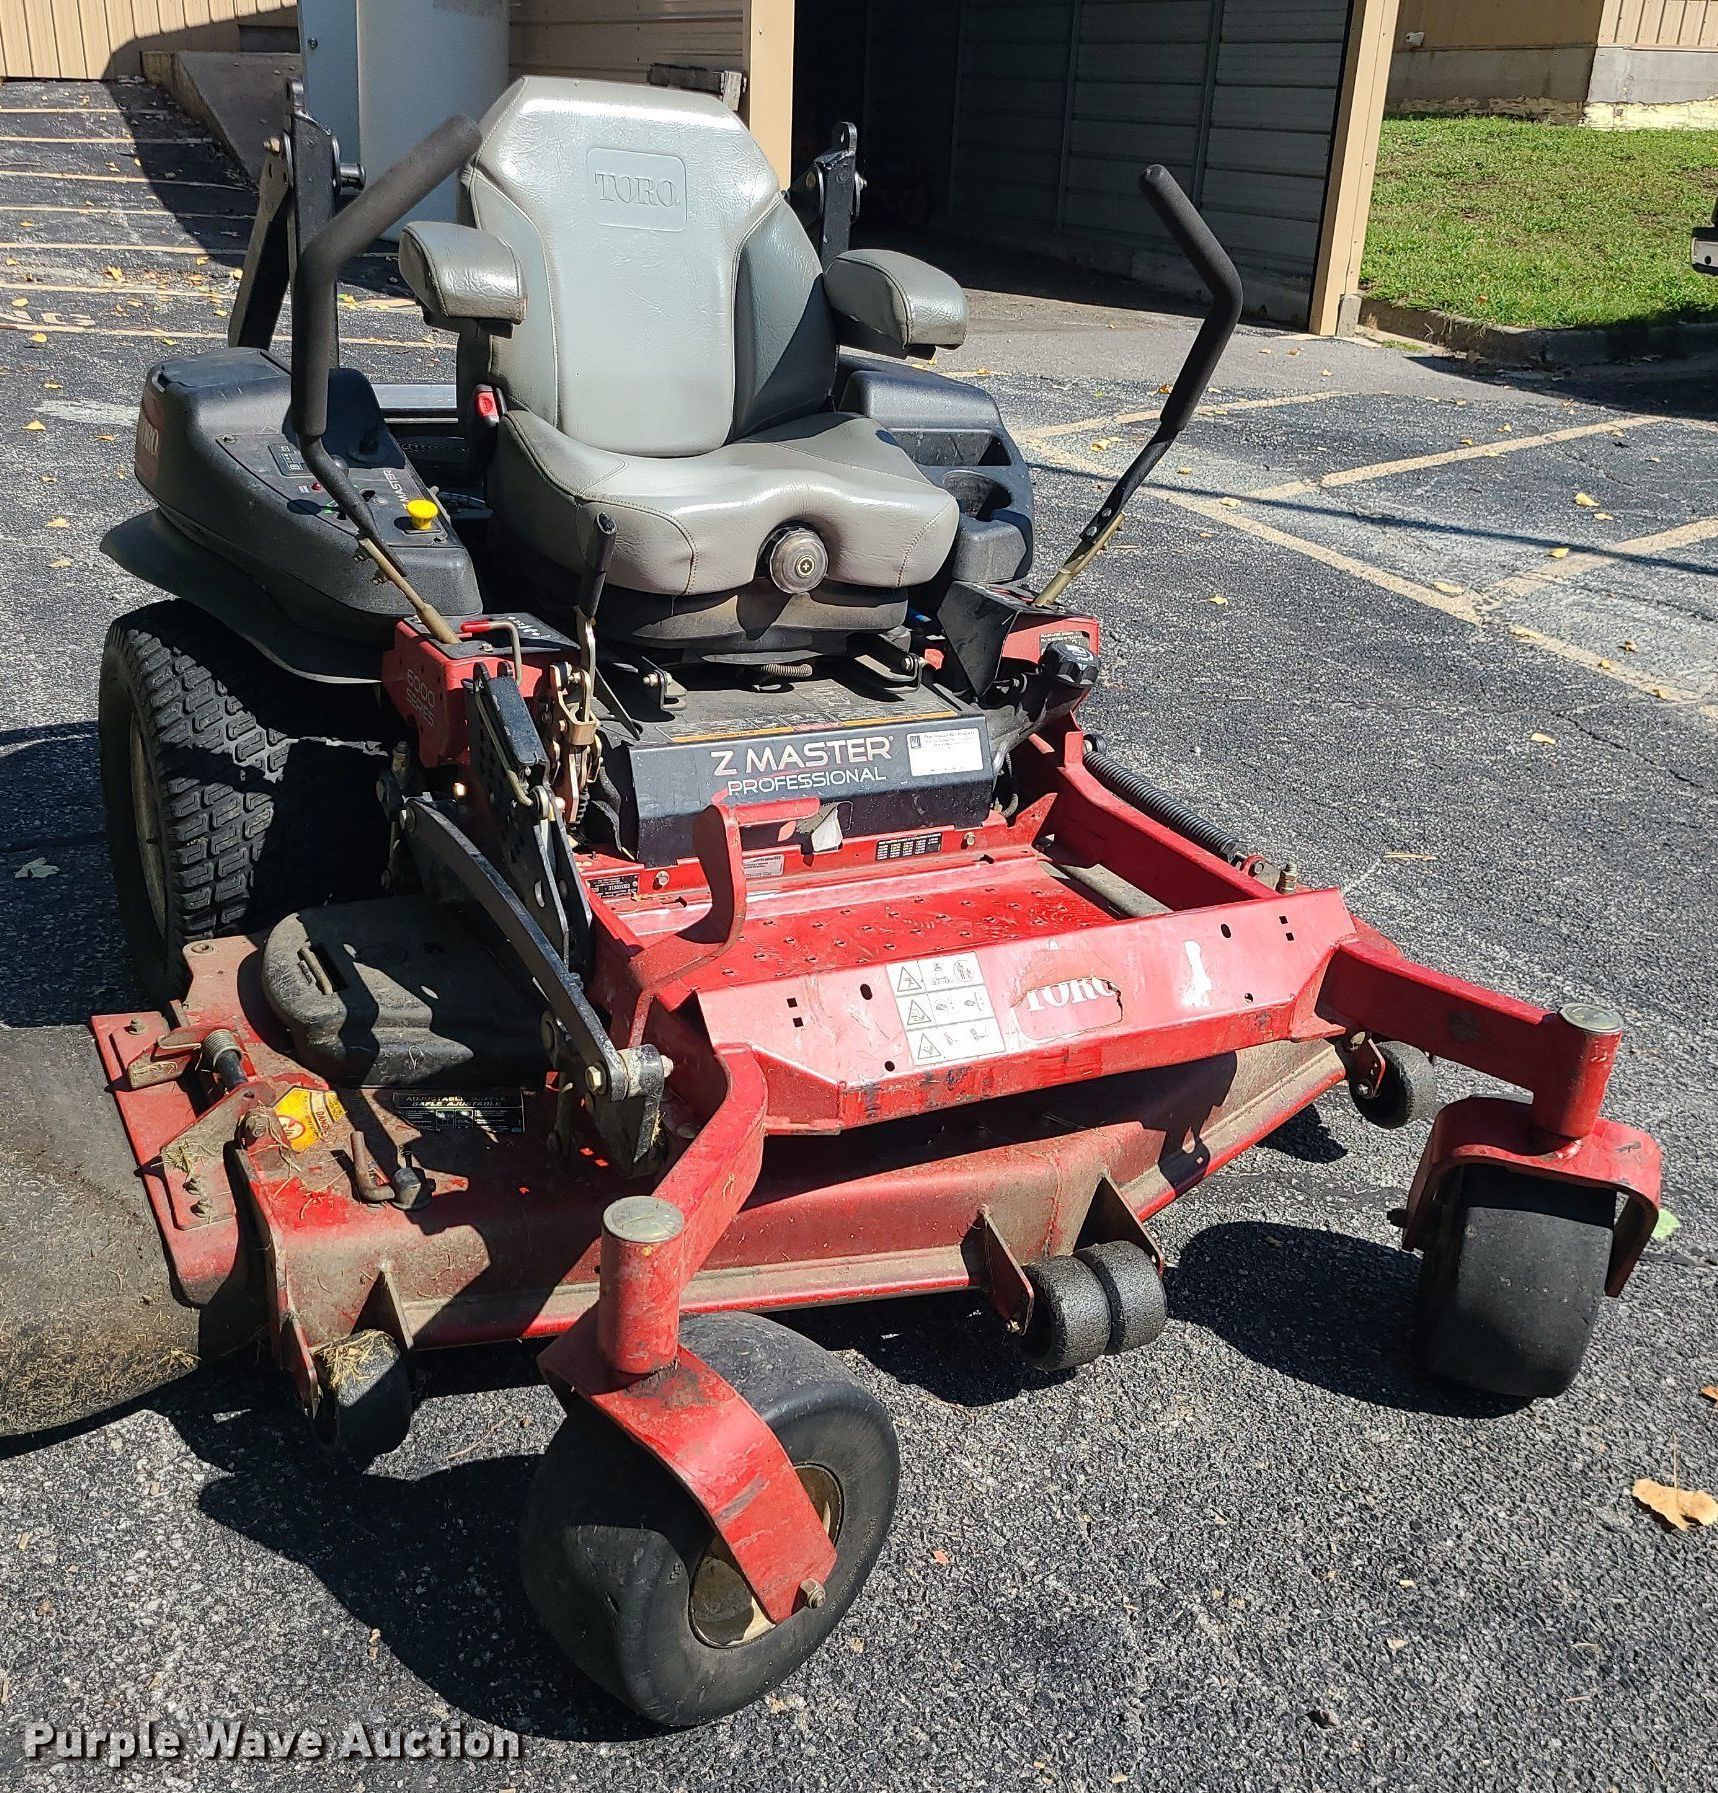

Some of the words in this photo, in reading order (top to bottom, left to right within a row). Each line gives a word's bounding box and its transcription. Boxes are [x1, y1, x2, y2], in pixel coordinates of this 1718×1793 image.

[594, 172, 679, 208] TORO
[406, 687, 434, 727] SERIES
[407, 667, 435, 708] 6000
[710, 750, 738, 777] Z
[745, 736, 893, 774] MASTER
[727, 766, 887, 797] PROFESSIONAL
